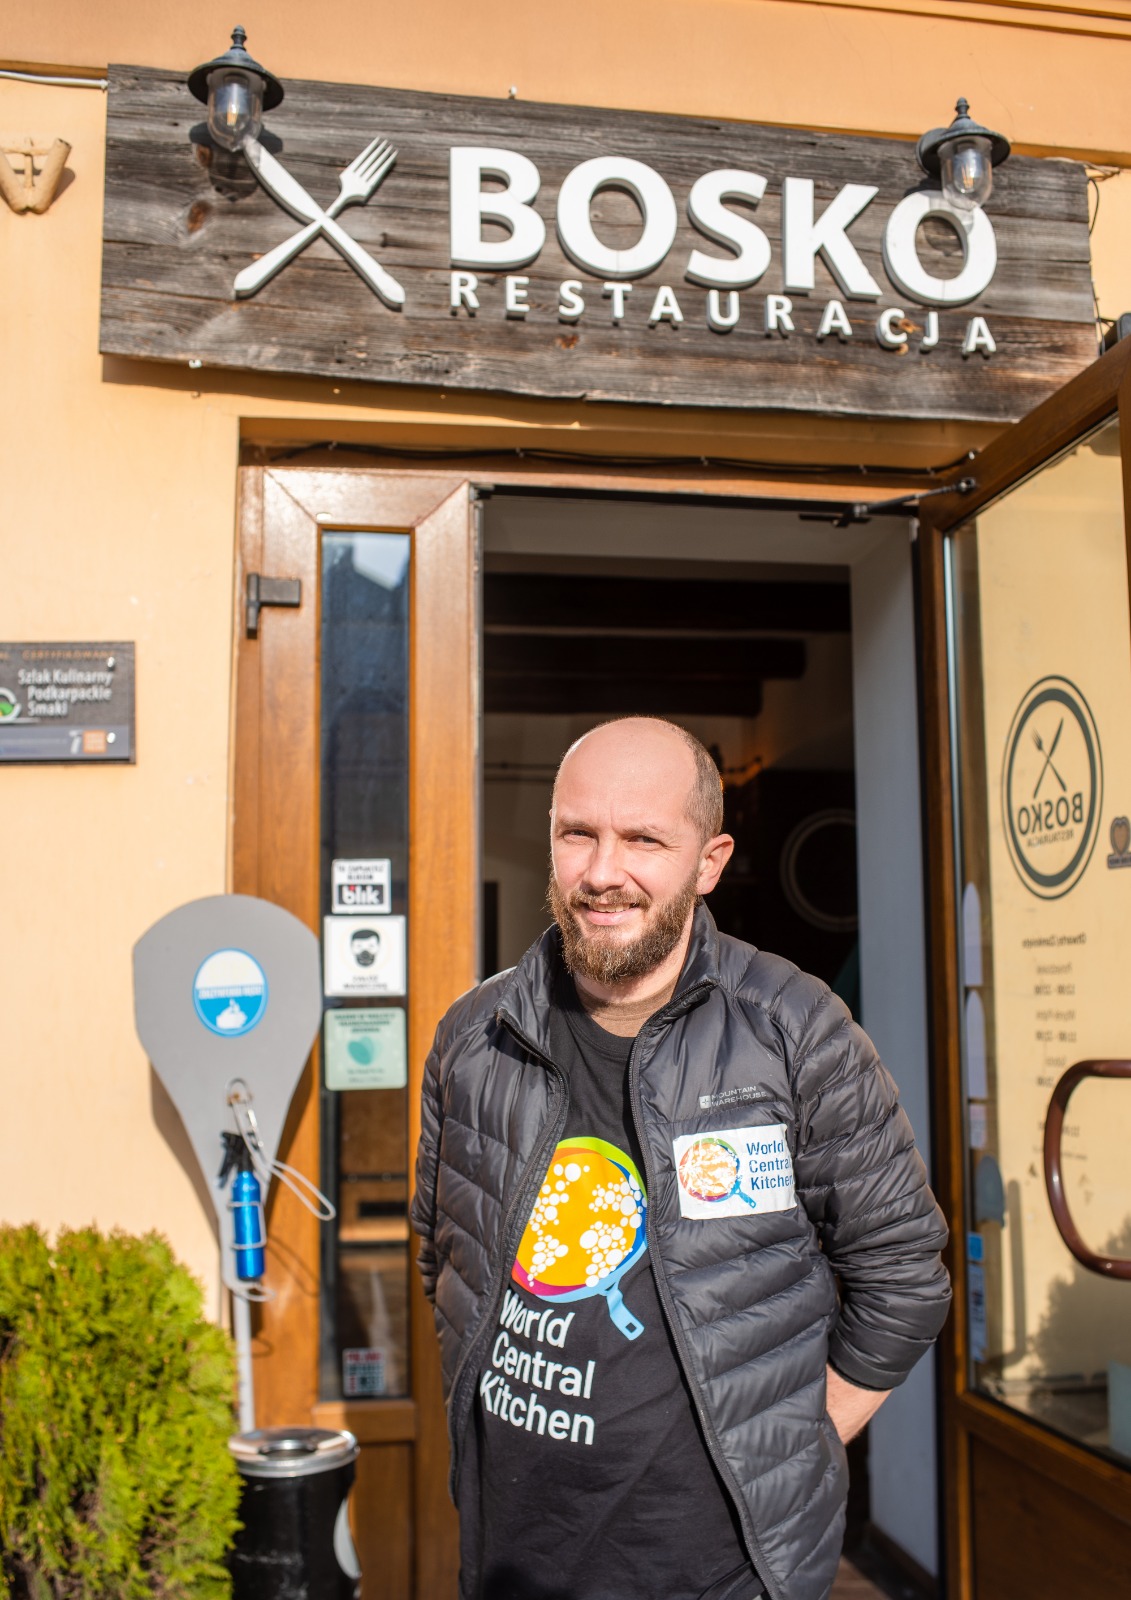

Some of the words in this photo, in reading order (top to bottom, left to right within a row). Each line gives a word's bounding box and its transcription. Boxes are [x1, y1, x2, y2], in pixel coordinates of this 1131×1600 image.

[449, 146, 998, 307] BOSKO
[450, 270, 997, 357] RESTAURACJA
[18, 668, 51, 684] Szlak
[53, 668, 113, 686] Kulinarny
[28, 685, 112, 703] Podkarpackie
[28, 701, 68, 716] Smaki
[342, 885, 380, 904] blik
[711, 1086, 757, 1100] MOUNTAIN
[711, 1091, 767, 1107] WAREHOUSE
[746, 1140, 784, 1155] World
[500, 1289, 575, 1348] World
[492, 1331, 596, 1399] Central
[480, 1370, 595, 1445] Kitchen
